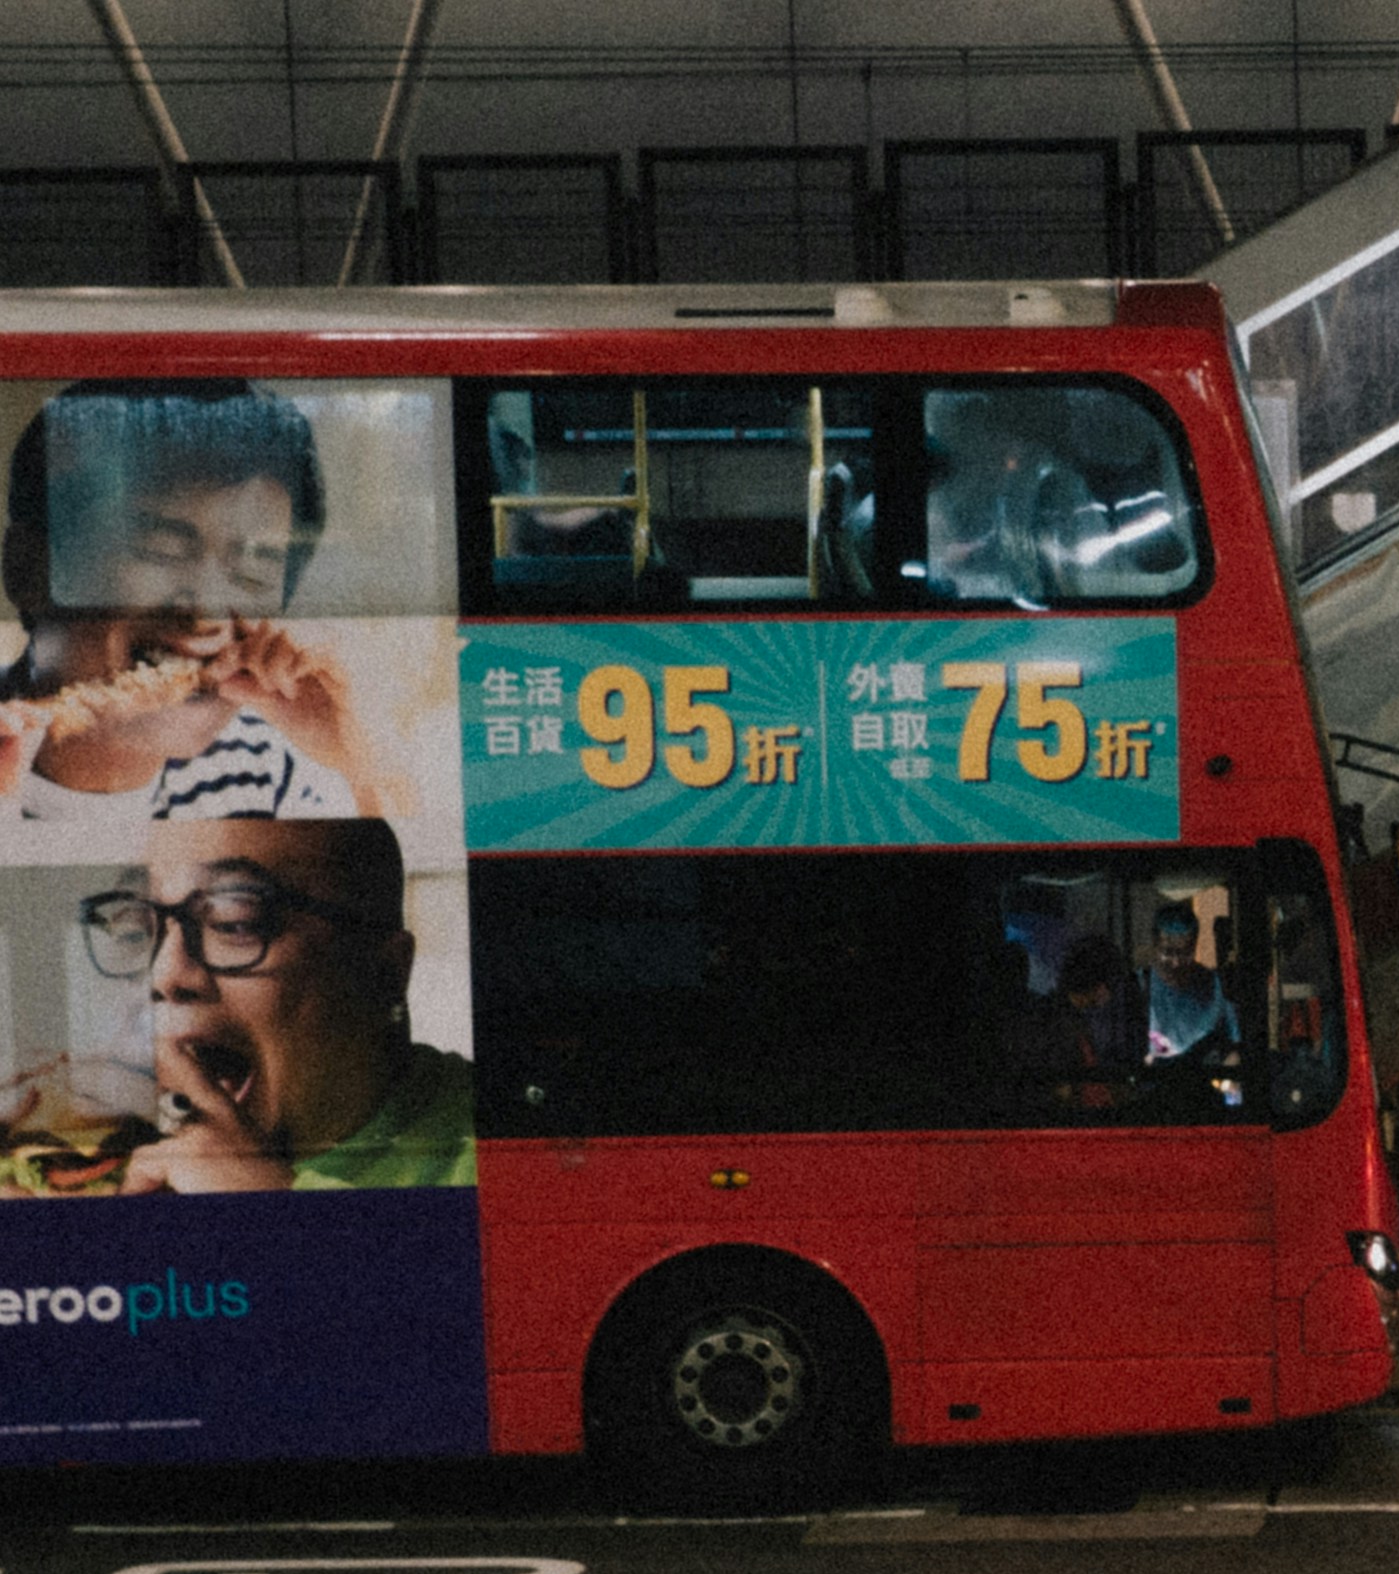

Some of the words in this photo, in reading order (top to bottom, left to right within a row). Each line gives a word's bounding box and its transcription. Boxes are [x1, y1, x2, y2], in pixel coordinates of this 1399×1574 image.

[482, 667, 563, 706] 生活
[848, 661, 928, 703] 外賣
[484, 715, 564, 755] 百貨
[852, 711, 930, 751] 自取
